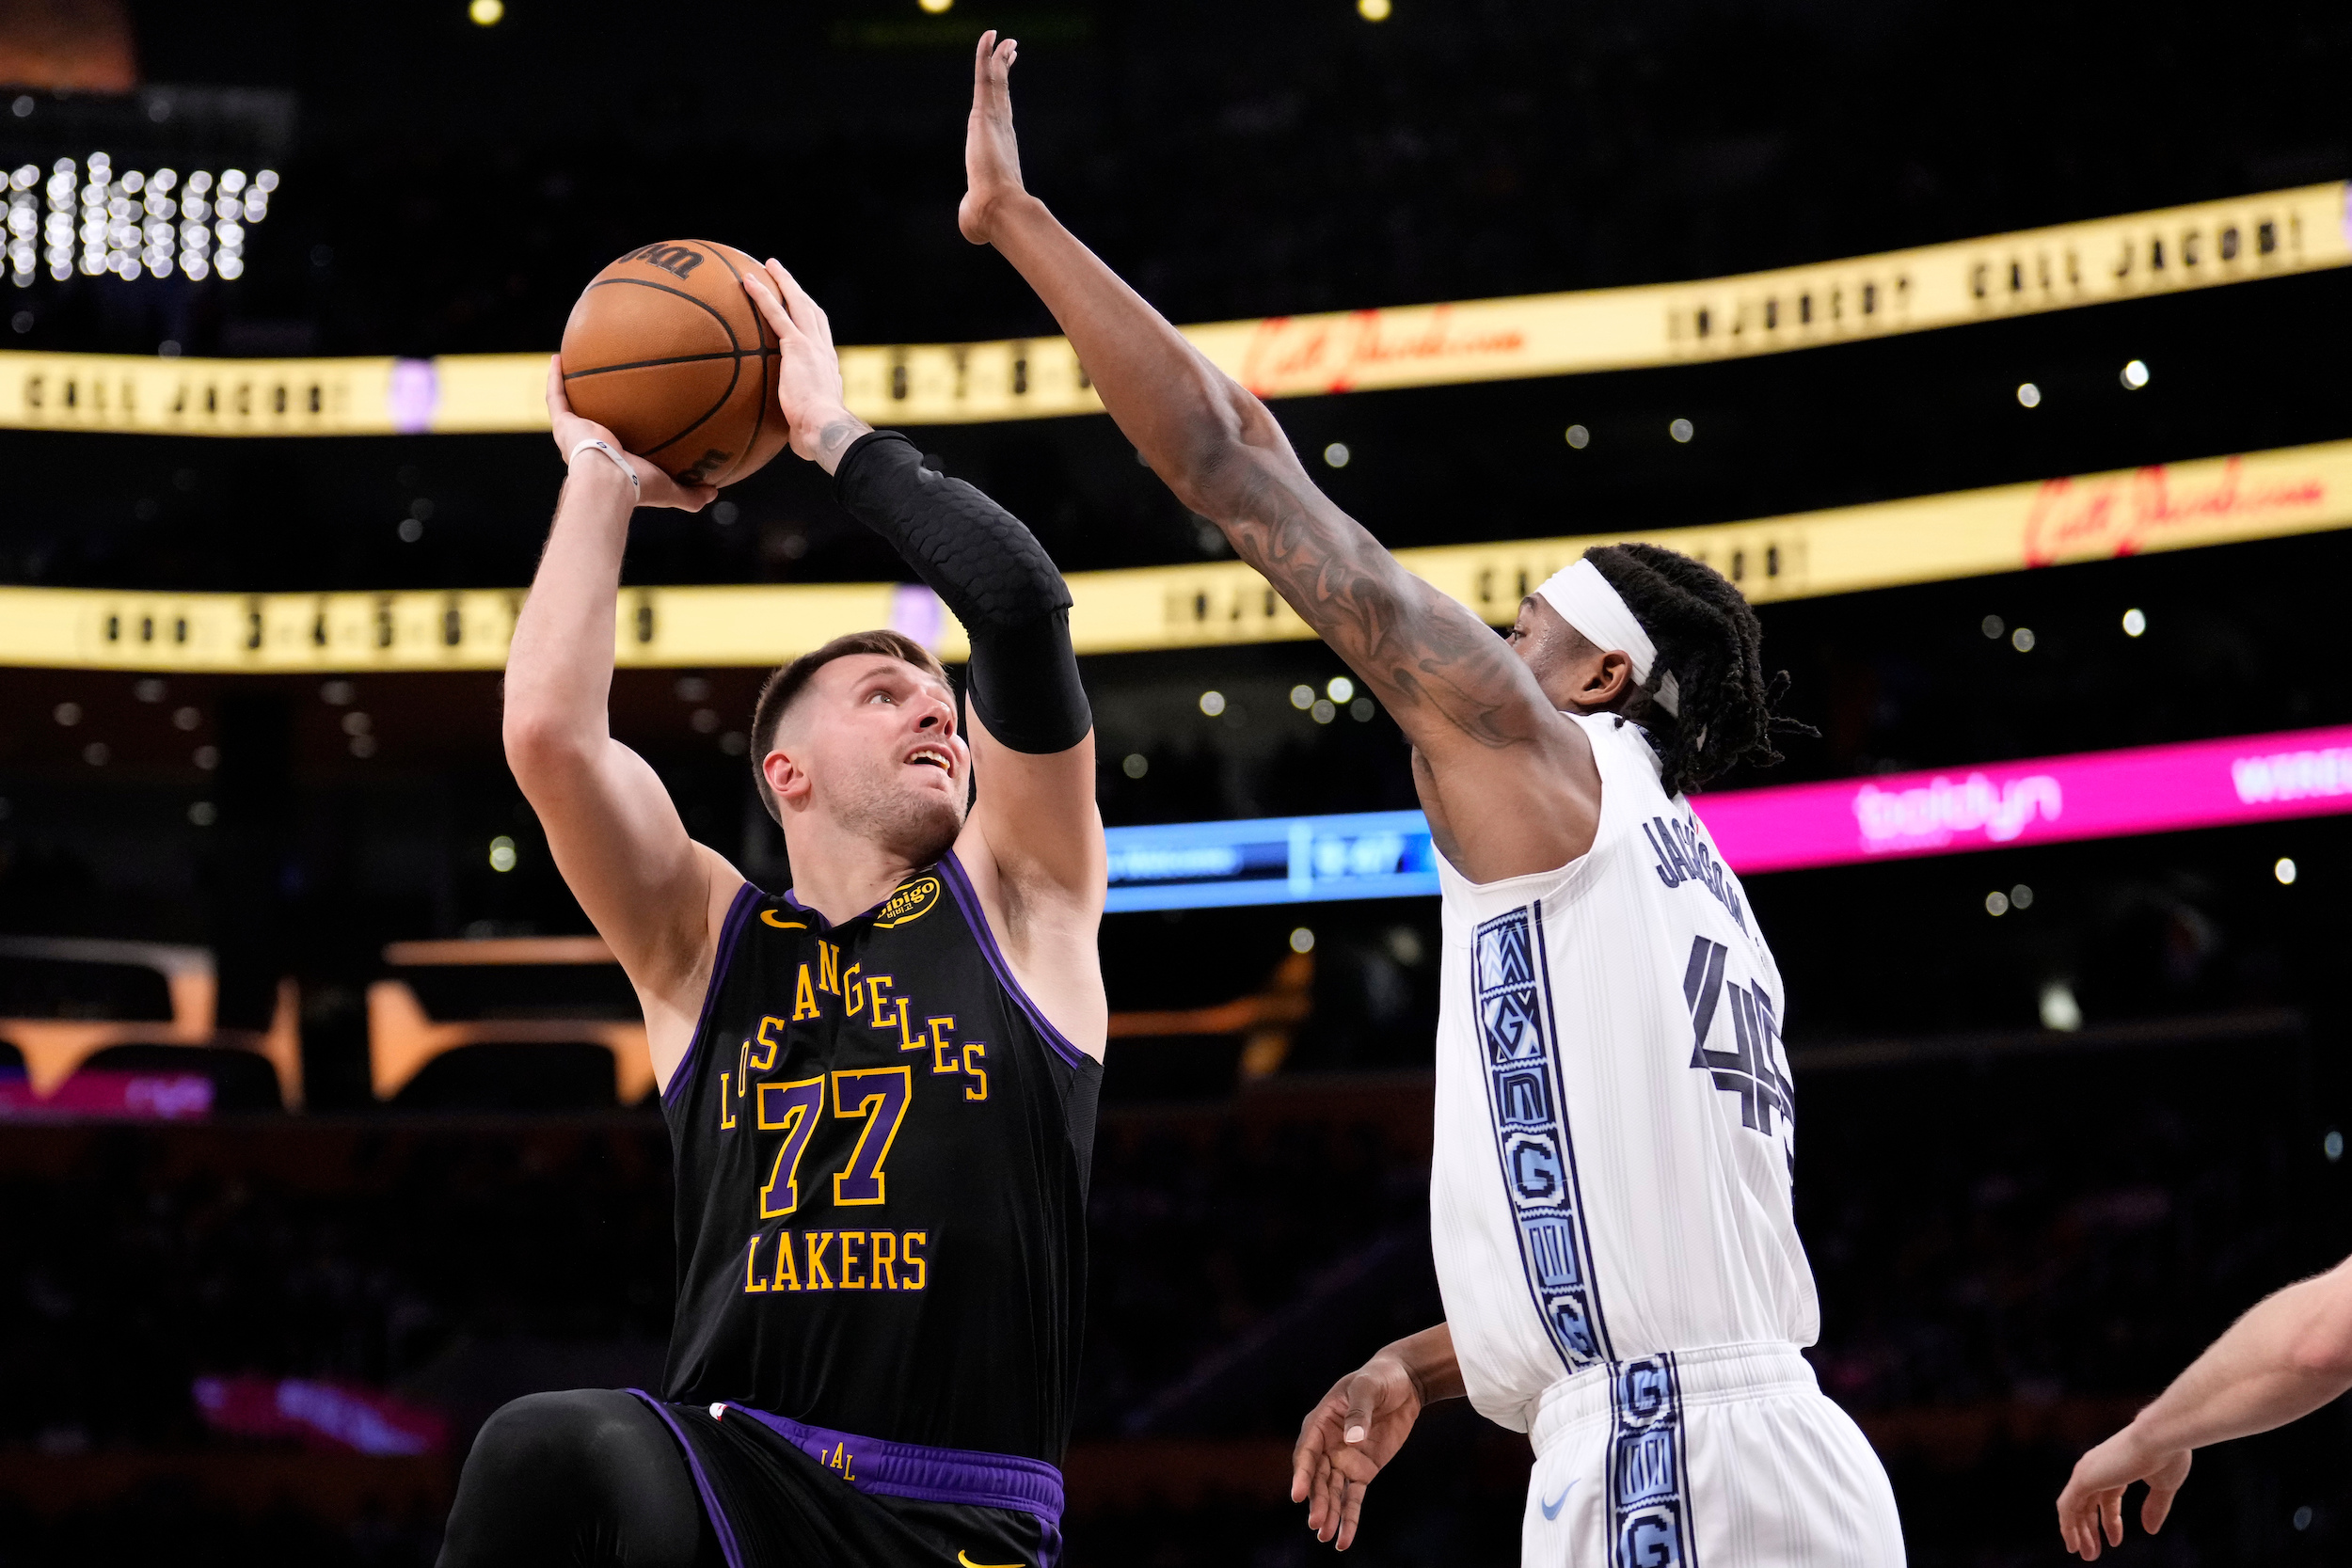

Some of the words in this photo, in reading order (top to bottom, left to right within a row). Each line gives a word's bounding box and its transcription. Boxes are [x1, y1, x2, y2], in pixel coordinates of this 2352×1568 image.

[1970, 248, 2079, 299] CALL
[23, 373, 138, 412] CALL
[1643, 816, 1750, 939] JACKSON
[720, 1016, 785, 1131] LOS
[792, 939, 988, 1101] ANGELES
[756, 1065, 912, 1219] 77
[744, 1229, 928, 1292] LAKERS
